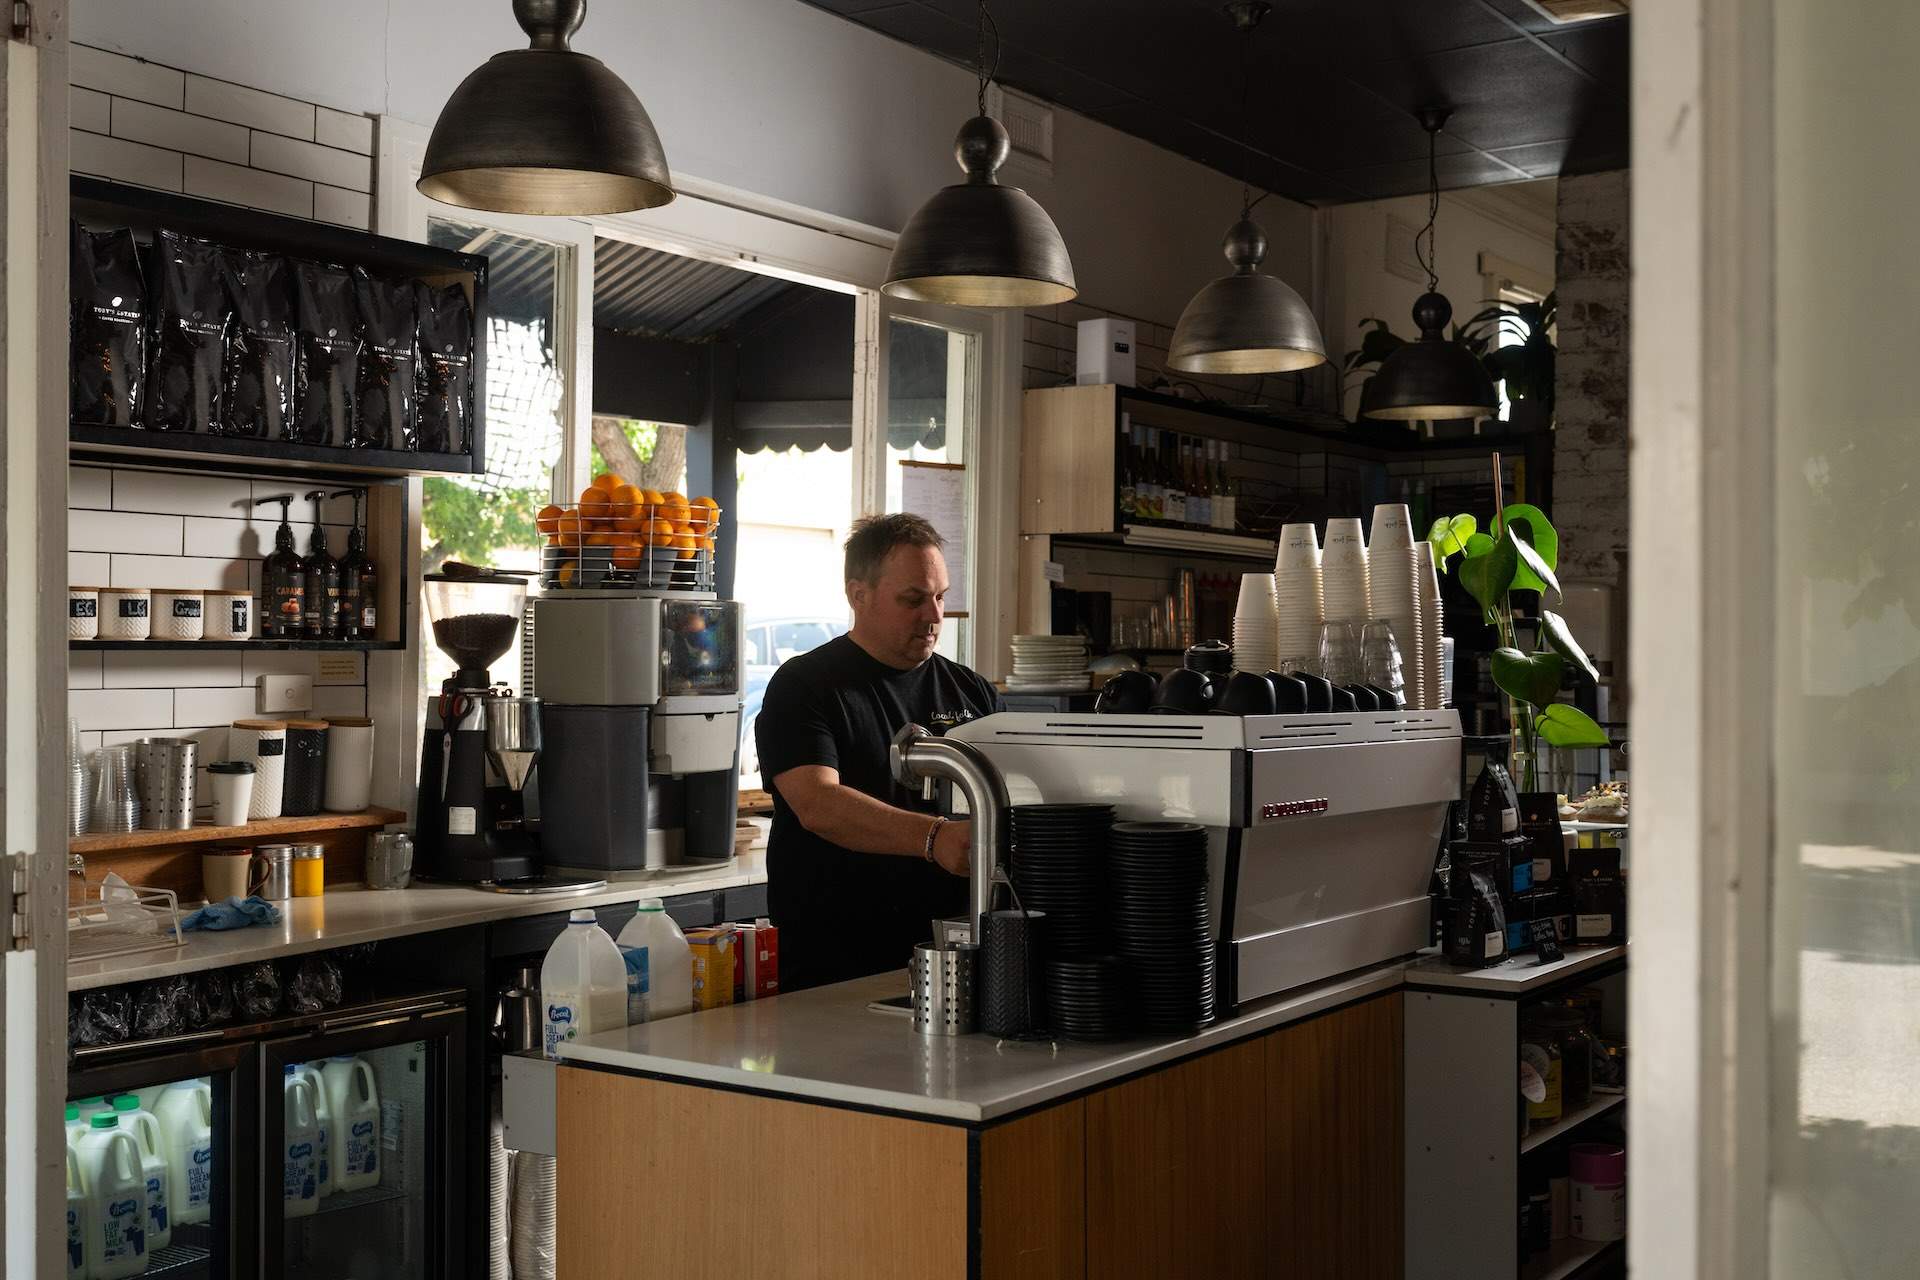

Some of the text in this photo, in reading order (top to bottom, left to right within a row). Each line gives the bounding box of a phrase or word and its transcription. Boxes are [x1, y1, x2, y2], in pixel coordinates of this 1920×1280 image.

[93, 306, 116, 315] TOBY'S
[545, 1024, 557, 1034] FULL
[546, 1033, 565, 1044] CREAM
[188, 1167, 204, 1176] FULL
[190, 1182, 207, 1194] MILK
